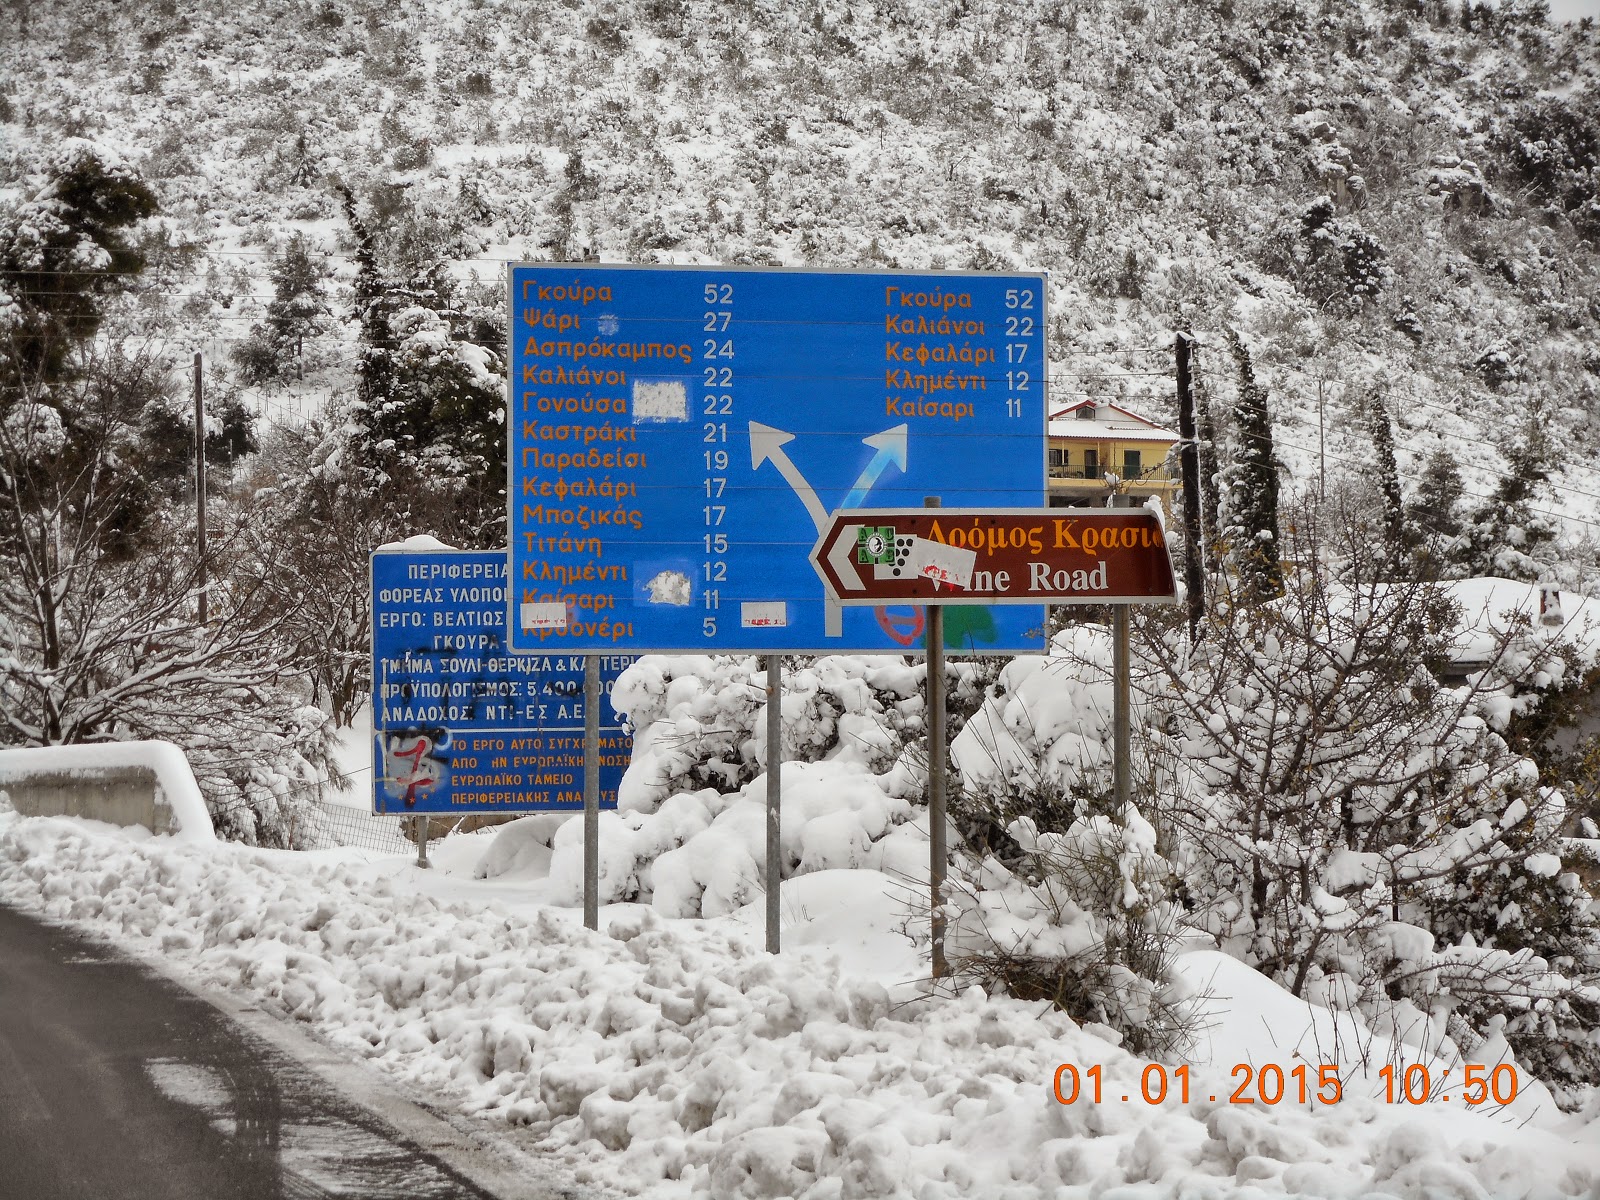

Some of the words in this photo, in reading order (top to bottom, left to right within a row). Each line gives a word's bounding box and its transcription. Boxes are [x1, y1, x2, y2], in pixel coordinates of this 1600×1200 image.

[522, 279, 613, 306] Γκούρα
[703, 283, 734, 305] 52
[885, 286, 972, 312] Γκούρα
[1004, 289, 1034, 310] 52
[523, 308, 581, 333] Ψάρι
[703, 312, 733, 332] 27
[885, 314, 985, 336] Καλιάνοι
[1004, 316, 1034, 337] 22
[523, 336, 693, 364] Ασπρόκαμπος
[703, 339, 735, 360] 24
[885, 341, 996, 367] Κεφαλάρι
[1005, 343, 1029, 364] 17
[522, 364, 627, 386] Καλιάνοι
[703, 367, 733, 387] 22
[885, 369, 987, 394] Κλημέντι
[1005, 371, 1030, 391] 12
[522, 392, 627, 414] Γονούσα
[703, 395, 733, 415] 22
[885, 396, 975, 423] Καίσαρι
[1005, 398, 1022, 418] 11
[522, 420, 637, 446] Καστράκι
[703, 422, 728, 443] 21
[522, 447, 647, 473] Παραδείσι
[703, 450, 729, 470] 19
[522, 475, 637, 502] Κεφαλάρι
[703, 477, 728, 498] 17
[522, 503, 643, 531] Μποζικάς
[703, 505, 727, 526] 17
[523, 530, 602, 558] Τιτάνη
[703, 533, 729, 554] 15
[522, 560, 628, 586] Κλημέντι
[703, 561, 728, 582] 12
[1027, 560, 1110, 592] Road
[379, 587, 444, 604] ΦΟΡΕΑΣ
[703, 589, 720, 610] 11
[379, 612, 426, 628] ΕΡΓΟ:
[703, 617, 717, 637] 5
[434, 634, 500, 651] ΓΚΟΥΡΑ
[555, 658, 568, 672] &
[451, 739, 467, 751] ΤΟ
[473, 739, 505, 751] ΕΡΓΟ
[510, 738, 543, 750] ΑΥΤΟ
[451, 757, 478, 769] ΑΠΟ
[451, 772, 522, 787] ΕΥΡΩΠΑΪΚΟ
[528, 774, 573, 786] ΤΑΜΕΙΟ
[451, 791, 550, 804] ΠΕΡΙΦΕΡΕΙΑΚΗΣ
